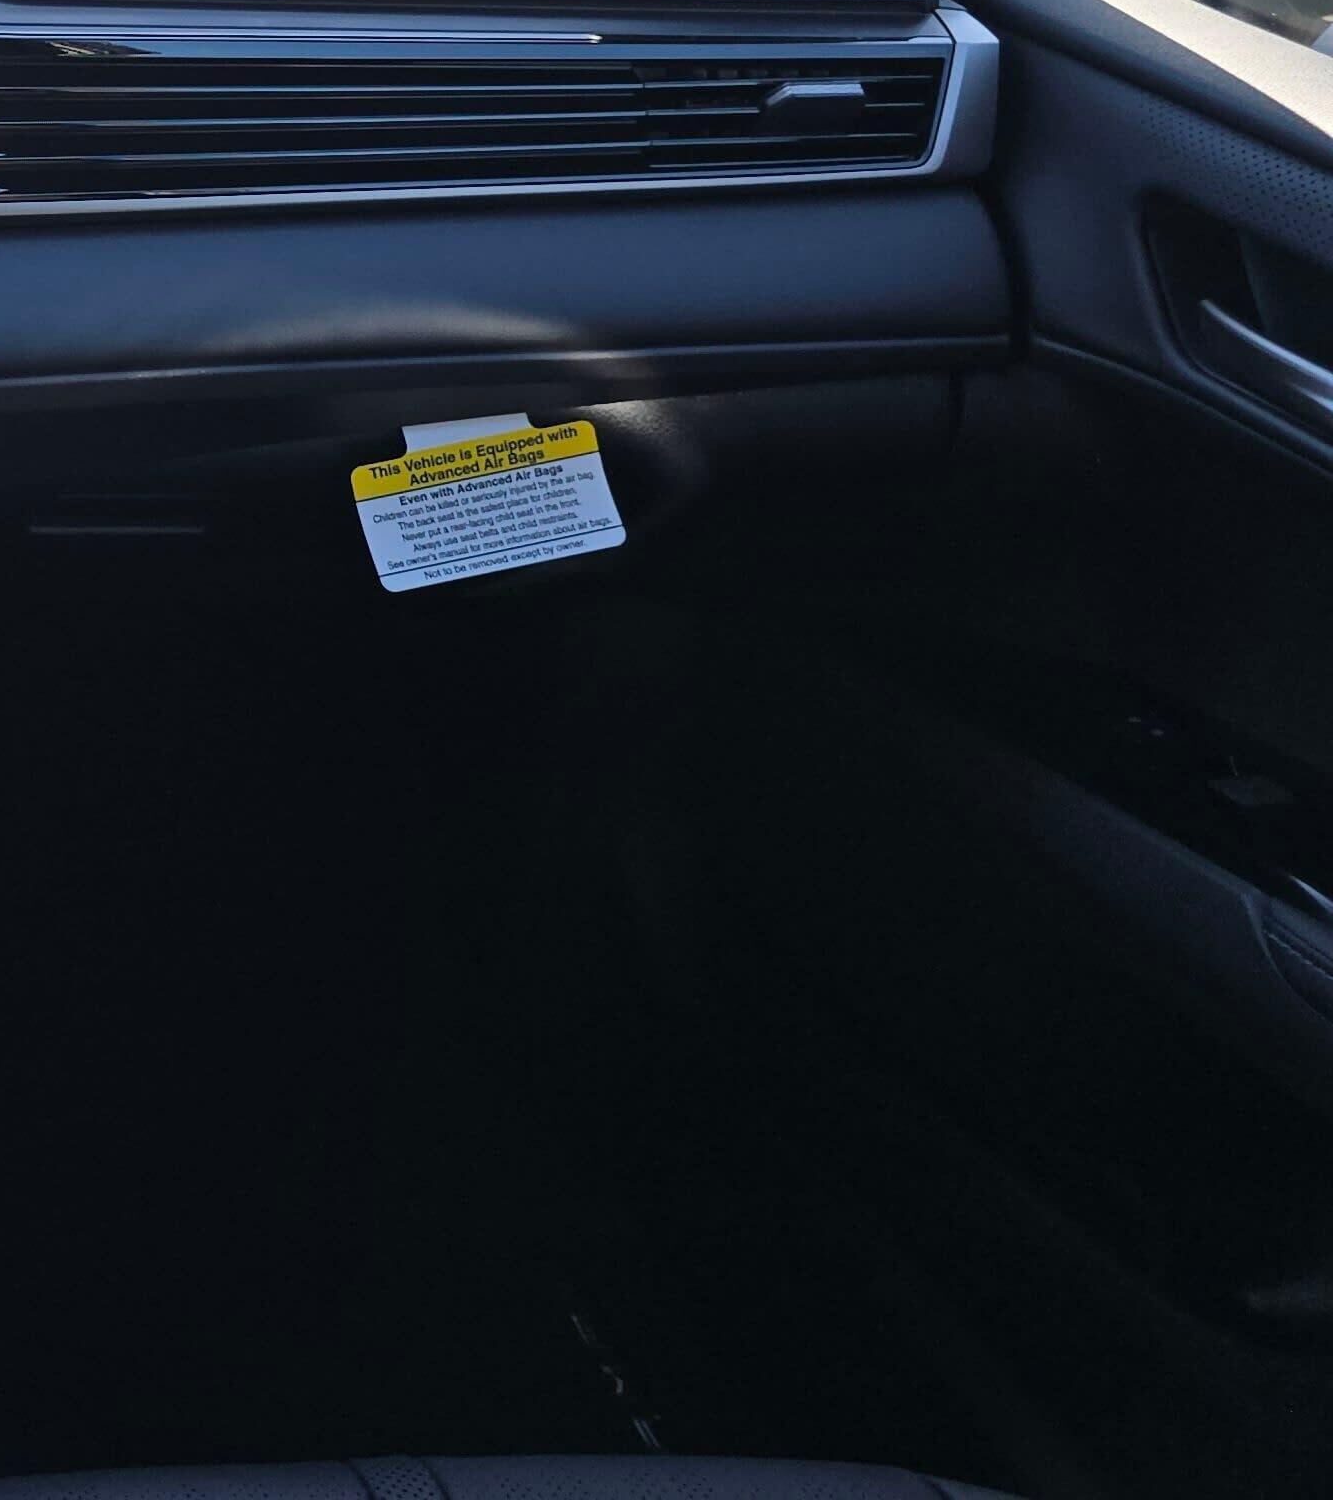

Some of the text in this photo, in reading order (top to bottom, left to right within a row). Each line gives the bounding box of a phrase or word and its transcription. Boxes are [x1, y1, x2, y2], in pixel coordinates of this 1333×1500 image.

[368, 426, 579, 480] This Vehicle is Equipped with
[410, 449, 545, 486] Advanced Air Bags
[373, 510, 408, 524] Children
[409, 507, 423, 518] can
[425, 503, 437, 513] be
[438, 498, 460, 510] killed
[461, 496, 470, 506] or
[550, 476, 564, 486] the
[399, 464, 564, 506] Even with Advanced Air Bags
[398, 520, 414, 531] The
[416, 516, 436, 528] back
[437, 512, 455, 524] seat
[465, 506, 479, 517] the
[402, 531, 426, 543] Never
[428, 527, 441, 539] put
[414, 540, 442, 553] Always
[443, 536, 459, 546] use
[460, 532, 478, 543] seat
[501, 523, 516, 534] and
[388, 560, 405, 571] See
[406, 553, 438, 567] owner's
[424, 568, 442, 580] Not
[444, 565, 453, 576] to
[455, 563, 467, 573] be
[469, 555, 509, 571] removed
[511, 548, 542, 563] except
[542, 546, 555, 557] by
